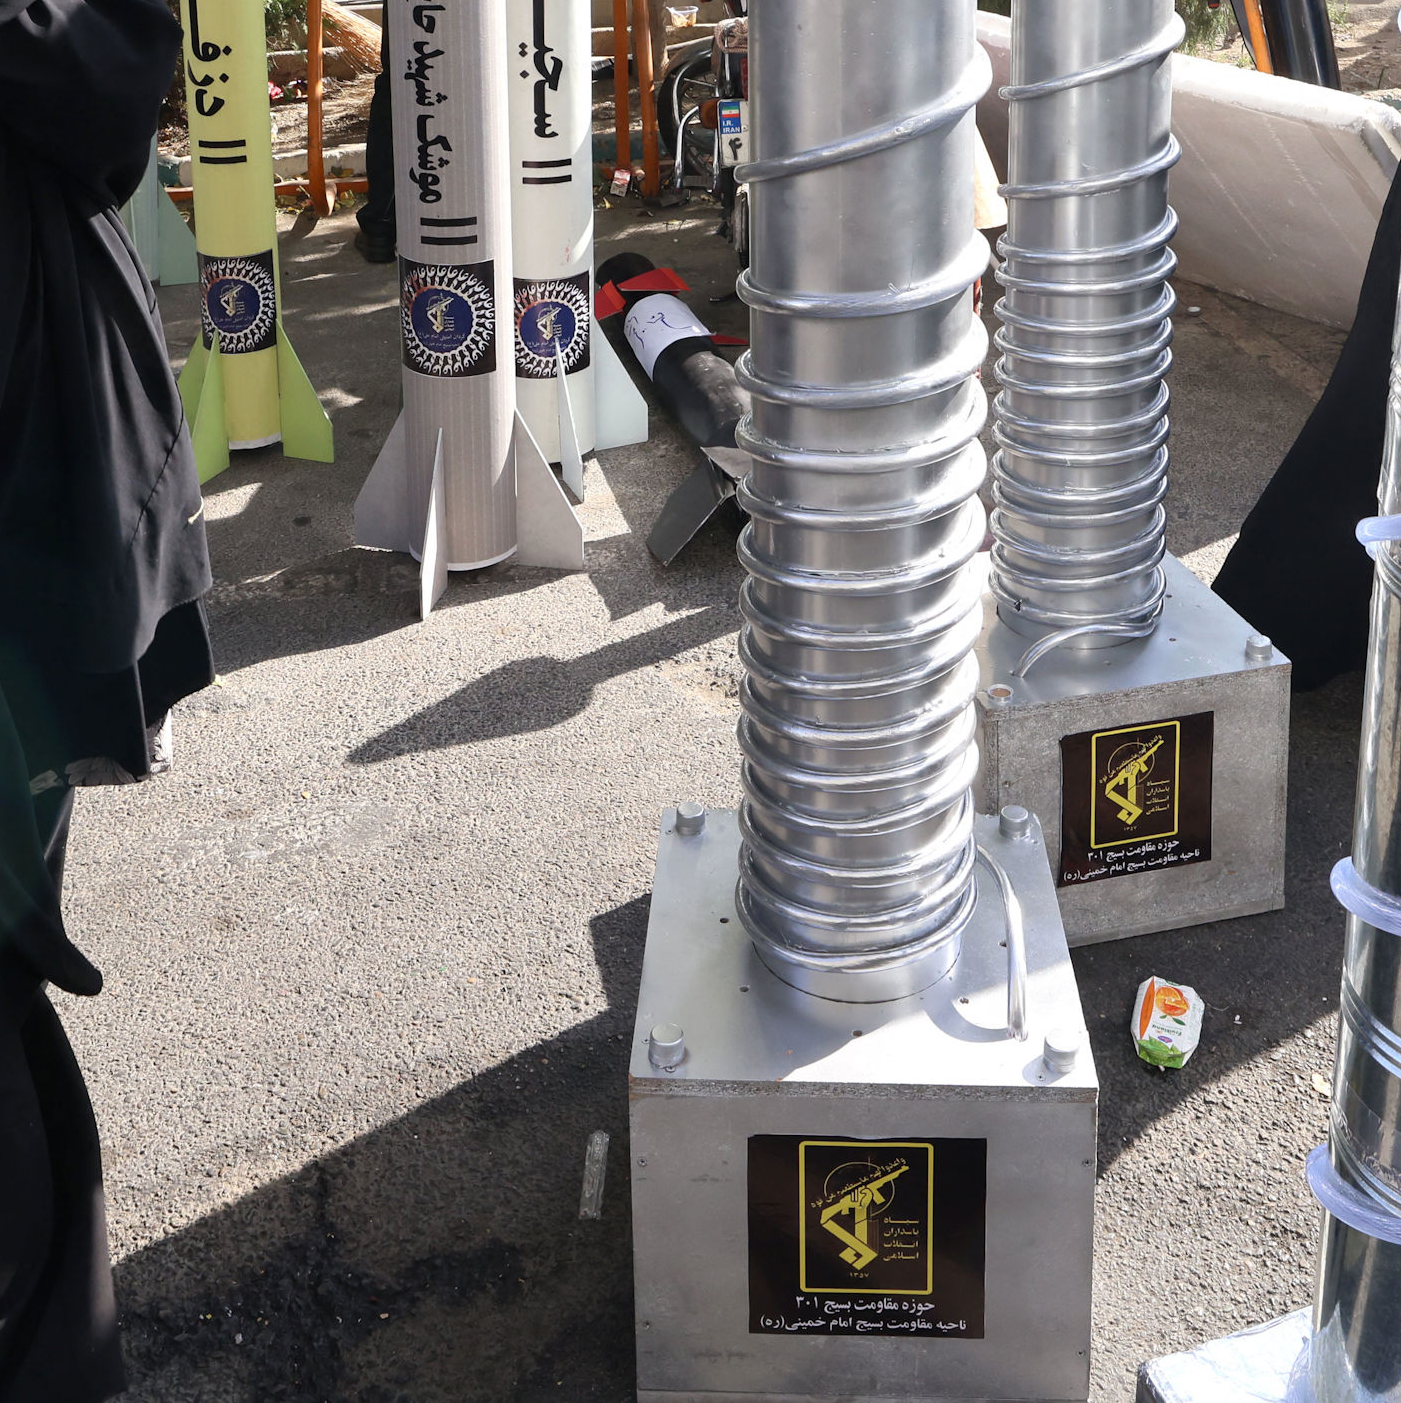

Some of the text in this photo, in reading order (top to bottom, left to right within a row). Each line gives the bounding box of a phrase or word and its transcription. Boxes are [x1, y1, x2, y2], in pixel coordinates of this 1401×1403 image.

[404, 41, 448, 106] شهید
[409, 114, 453, 204] موشک
[1126, 840, 1157, 857] مقاومت
[1157, 838, 1180, 852] حوزه
[1106, 849, 1125, 862] بسیج
[1147, 851, 1179, 866] مقاومت
[1179, 848, 1200, 860] ناحیه
[1109, 862, 1126, 874] امام
[1126, 859, 1146, 871] بسیج
[795, 1296, 936, 1316] حوزه مقاومت بسیج ۳۰۱
[829, 1317, 853, 1331] امام
[855, 1318, 884, 1332] بسیج
[886, 1316, 933, 1332] مقاومت
[936, 1319, 967, 1331] ناحیه
